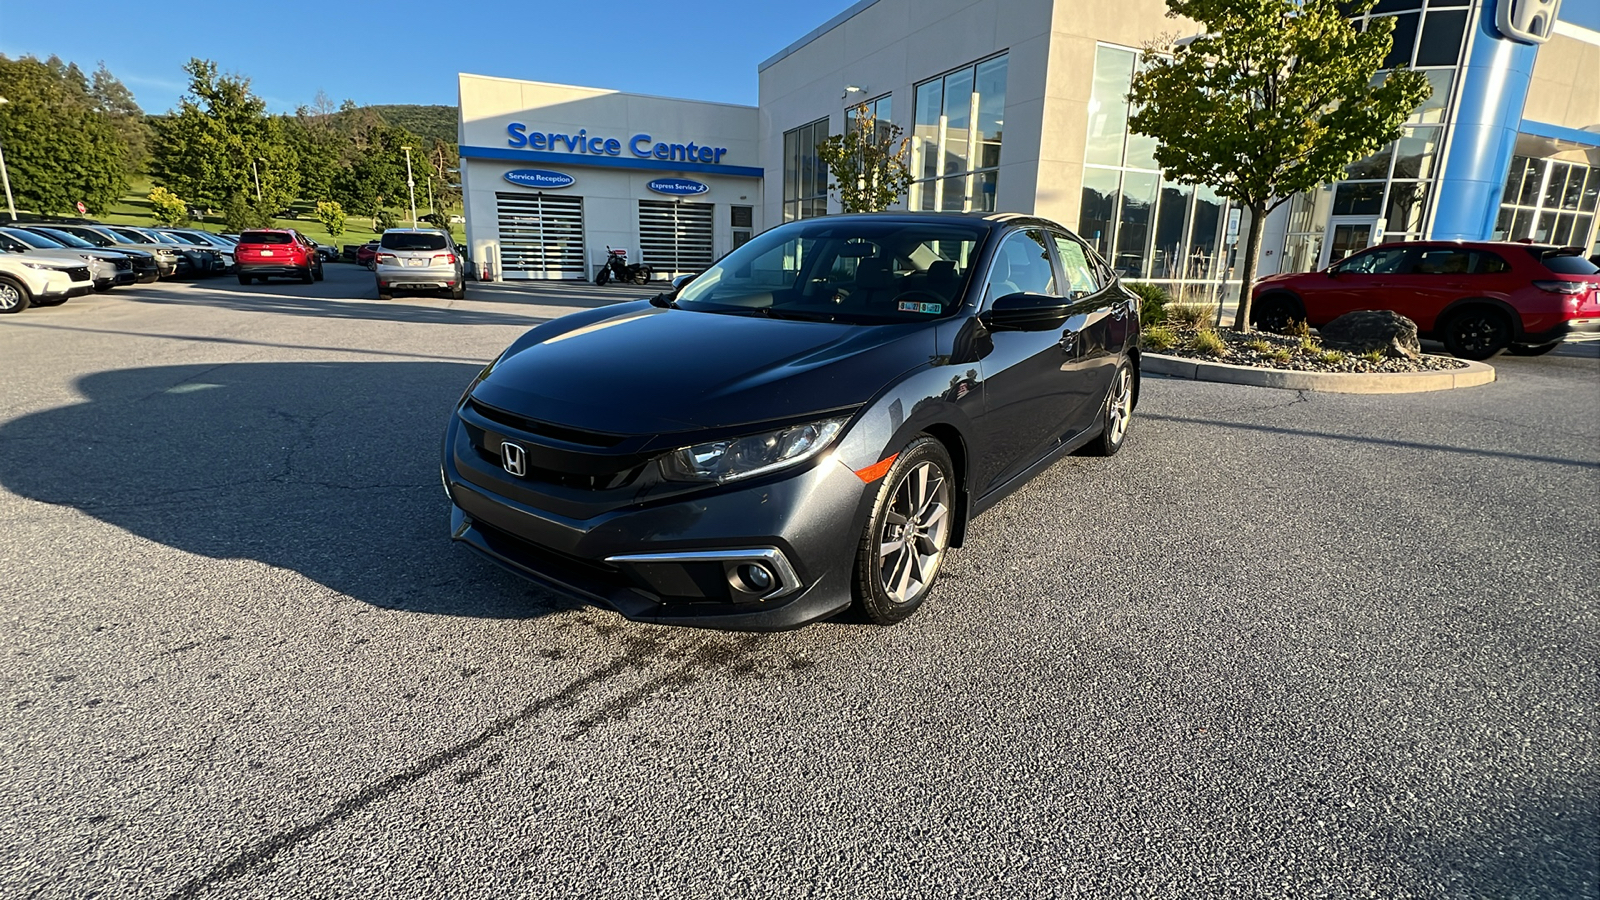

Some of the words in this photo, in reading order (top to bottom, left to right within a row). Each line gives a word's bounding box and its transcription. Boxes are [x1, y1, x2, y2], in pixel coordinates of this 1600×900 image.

[507, 122, 621, 155] Service
[628, 134, 727, 163] Center
[508, 172, 535, 181] Service
[536, 174, 571, 183] Reception
[651, 181, 674, 190] Express
[675, 183, 697, 191] Service
